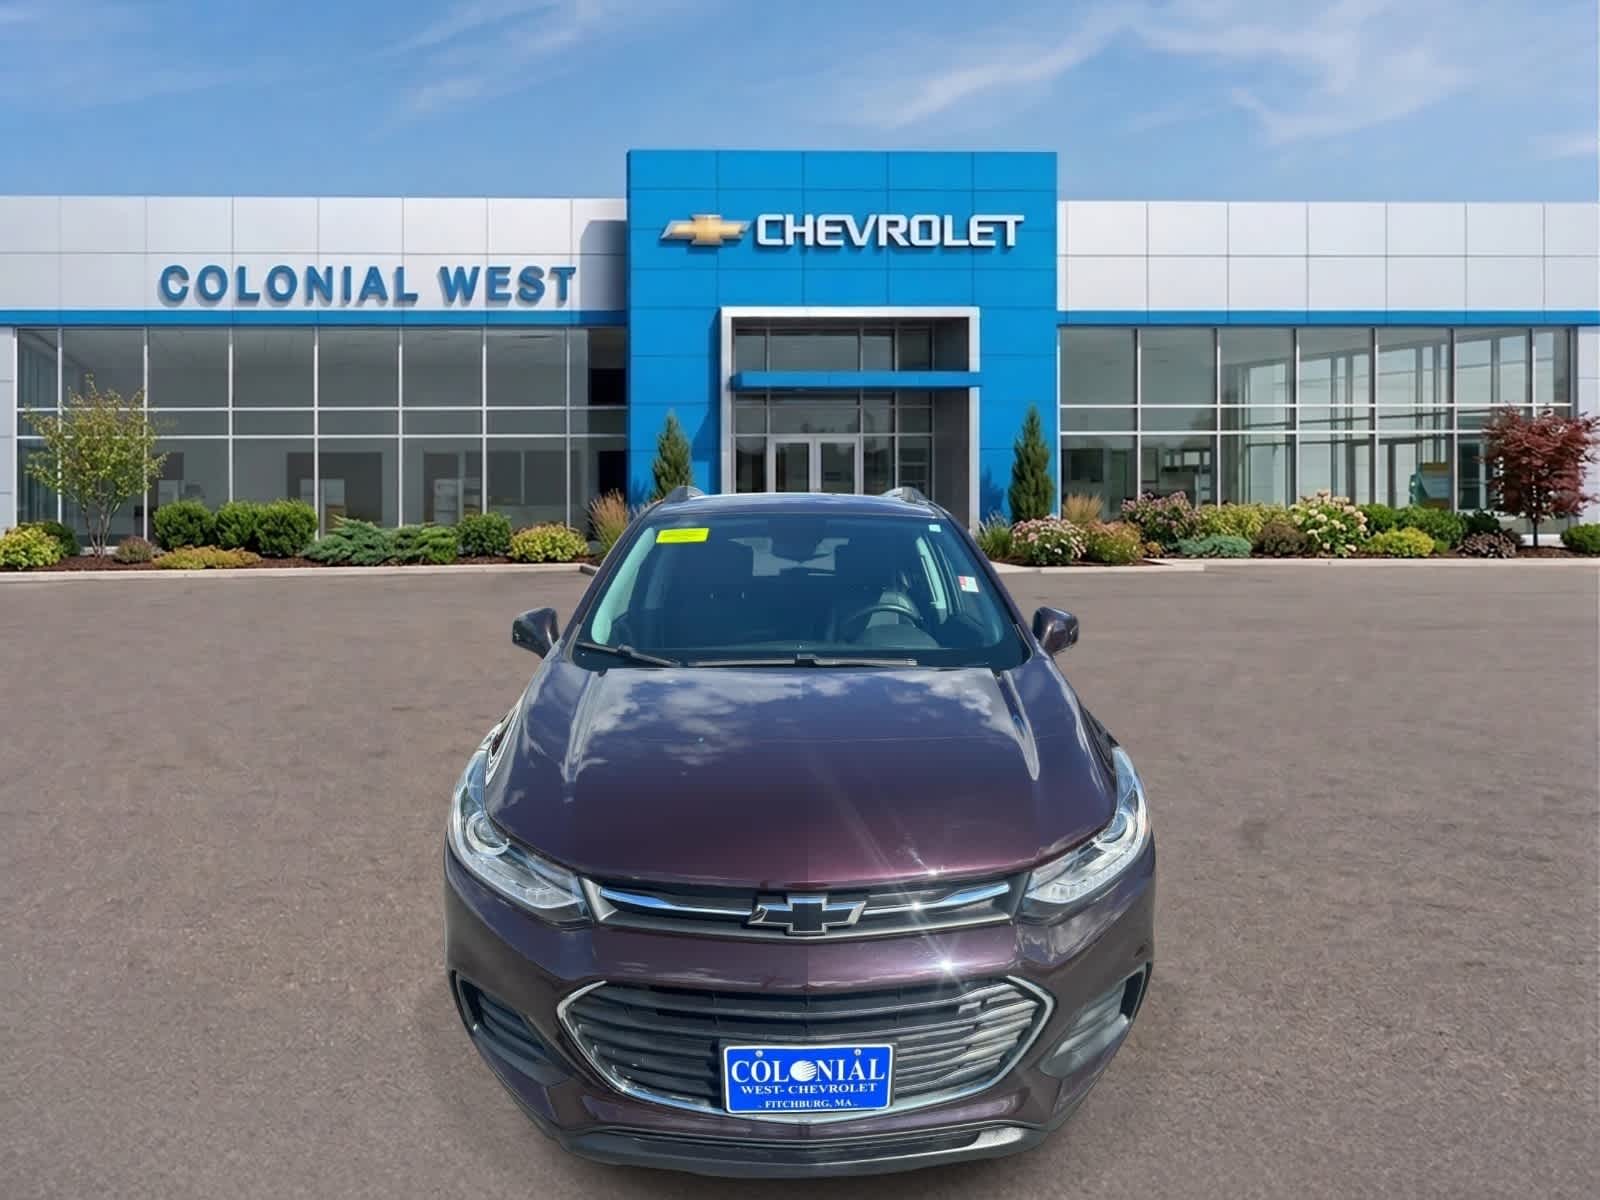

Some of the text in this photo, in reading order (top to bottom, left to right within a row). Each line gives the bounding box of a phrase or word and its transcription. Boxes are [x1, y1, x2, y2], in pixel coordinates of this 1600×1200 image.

[756, 213, 1025, 247] CHEVROLET
[159, 264, 577, 304] COLONIAL WEST
[788, 1083, 878, 1094] CHEVROLET
